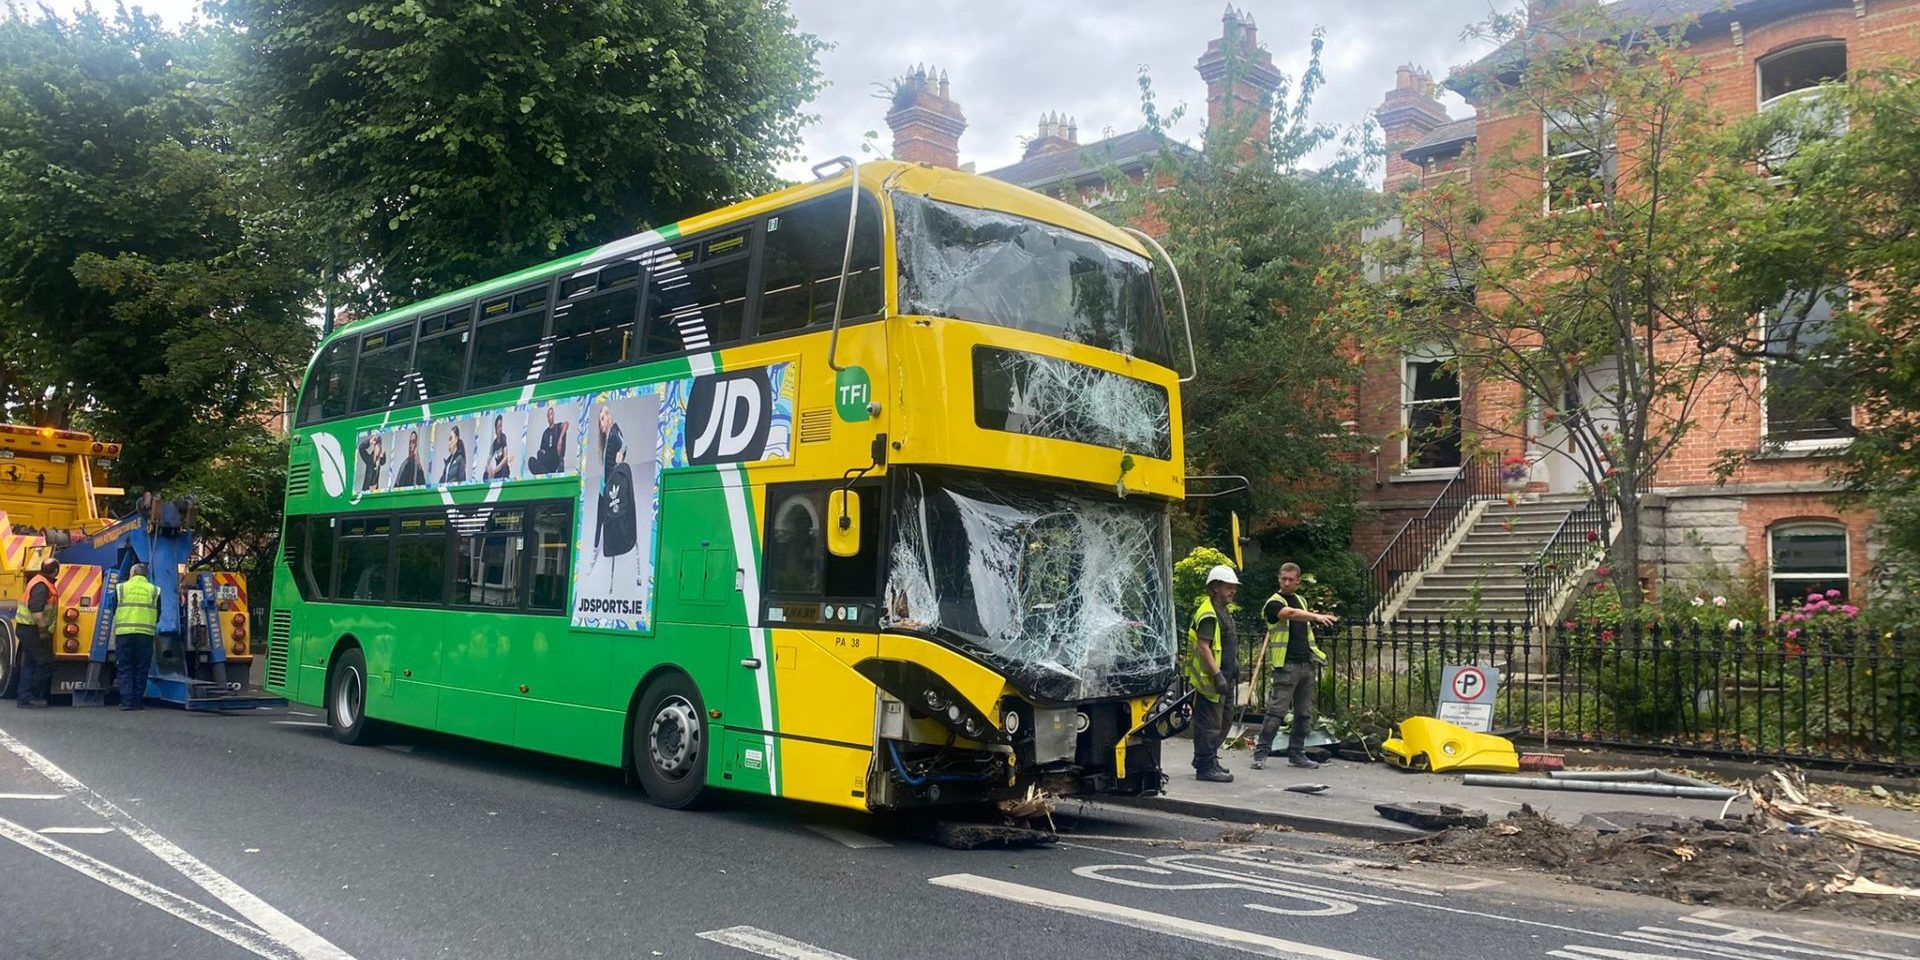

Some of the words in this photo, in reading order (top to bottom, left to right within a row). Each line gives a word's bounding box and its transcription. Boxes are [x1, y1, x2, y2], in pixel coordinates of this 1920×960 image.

[840, 384, 867, 405] TFI
[693, 378, 761, 459] JD
[578, 598, 642, 614] JDSPORTS.IE
[835, 637, 846, 647] PA
[851, 638, 860, 648] 38
[1462, 674, 1477, 694] P
